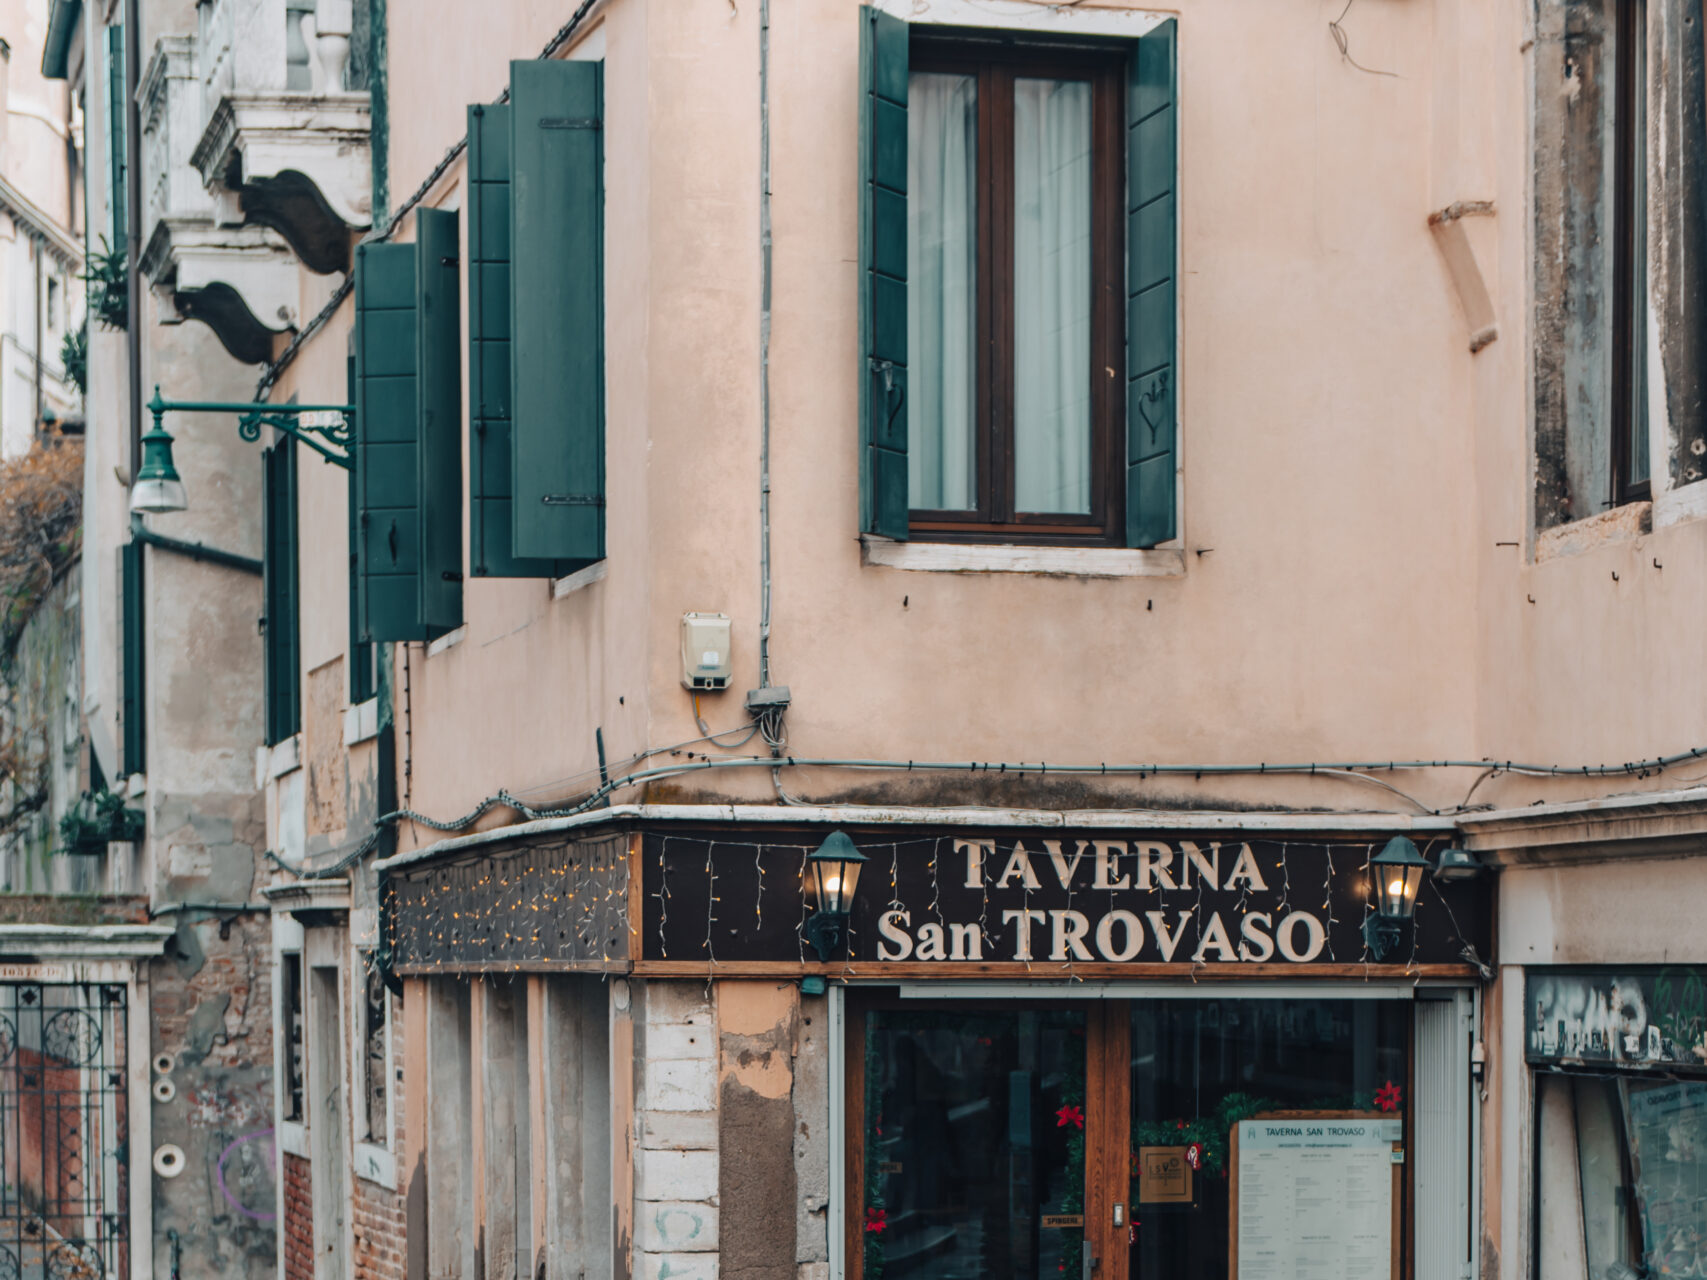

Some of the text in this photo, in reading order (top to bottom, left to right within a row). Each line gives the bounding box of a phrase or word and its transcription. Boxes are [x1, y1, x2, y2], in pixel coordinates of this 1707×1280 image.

[953, 838, 1269, 891] TAVERNA
[877, 909, 1325, 962] San TROVASO
[1265, 1127, 1365, 1137] TAVERNA SAN TROVASO
